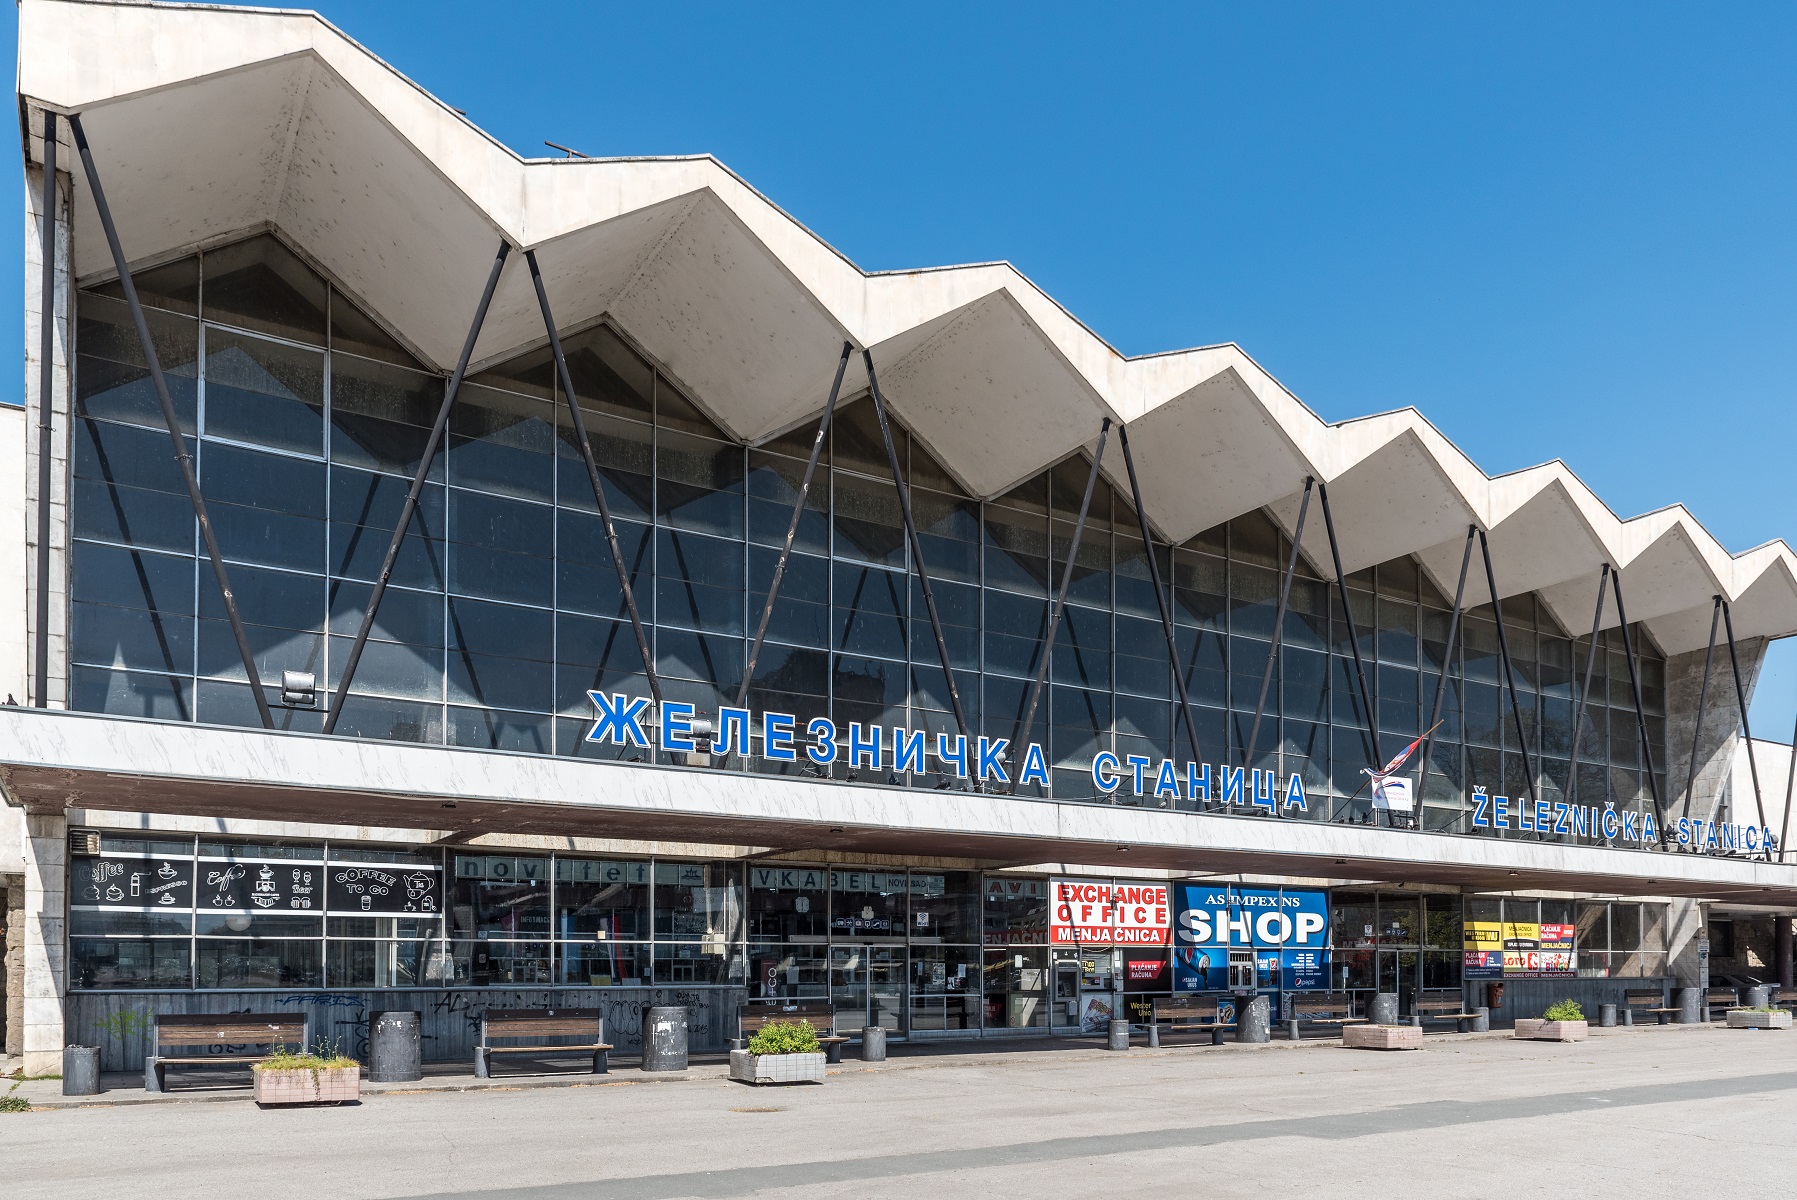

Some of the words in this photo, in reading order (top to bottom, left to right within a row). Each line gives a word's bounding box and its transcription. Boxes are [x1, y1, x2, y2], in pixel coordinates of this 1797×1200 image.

[586, 689, 1051, 787] ЖЕЛЕЗНИЧКА
[1092, 751, 1308, 815] СТАНИЦА
[1678, 817, 1774, 851] STANICA
[335, 868, 397, 887] COFFEE
[346, 884, 365, 893] TO
[369, 885, 389, 896] GO
[1058, 884, 1166, 905] EXCHANGE
[1205, 895, 1225, 905] AS
[1058, 904, 1166, 924] OFFICE
[1058, 927, 1160, 942] MENJAČNICA
[1178, 909, 1325, 944] SHOP
